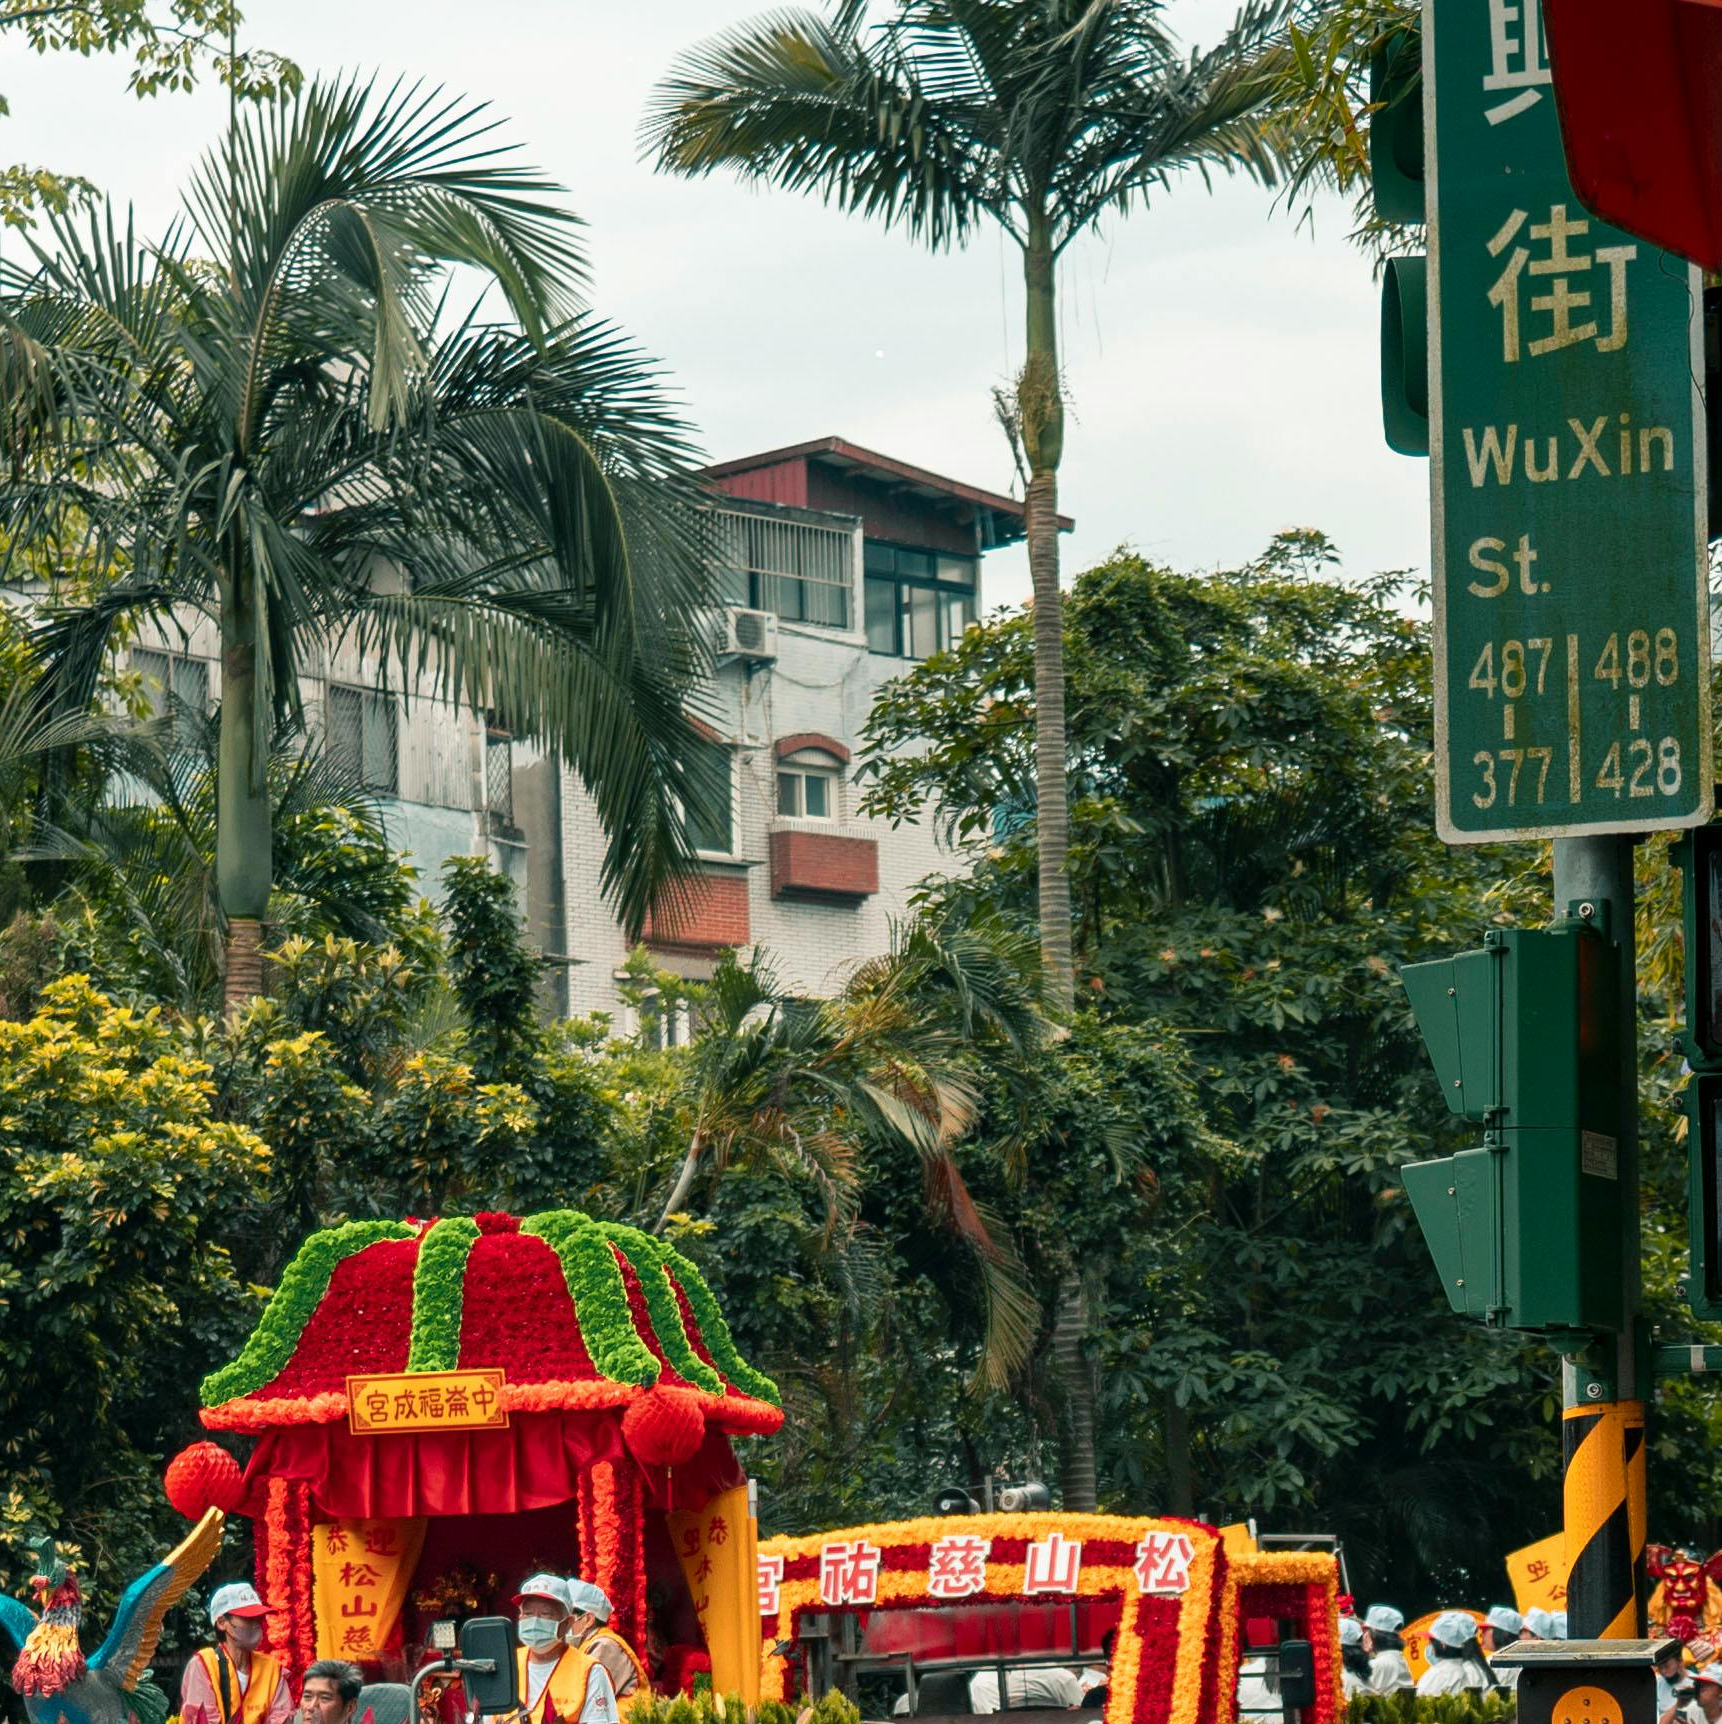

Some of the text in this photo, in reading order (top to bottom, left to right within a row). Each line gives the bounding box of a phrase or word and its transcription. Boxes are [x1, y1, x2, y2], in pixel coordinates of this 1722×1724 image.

[1463, 413, 1675, 488] WuXin
[1468, 536, 1551, 599] St.
[1469, 628, 1679, 698] 487 488
[1472, 737, 1681, 809] 377 428
